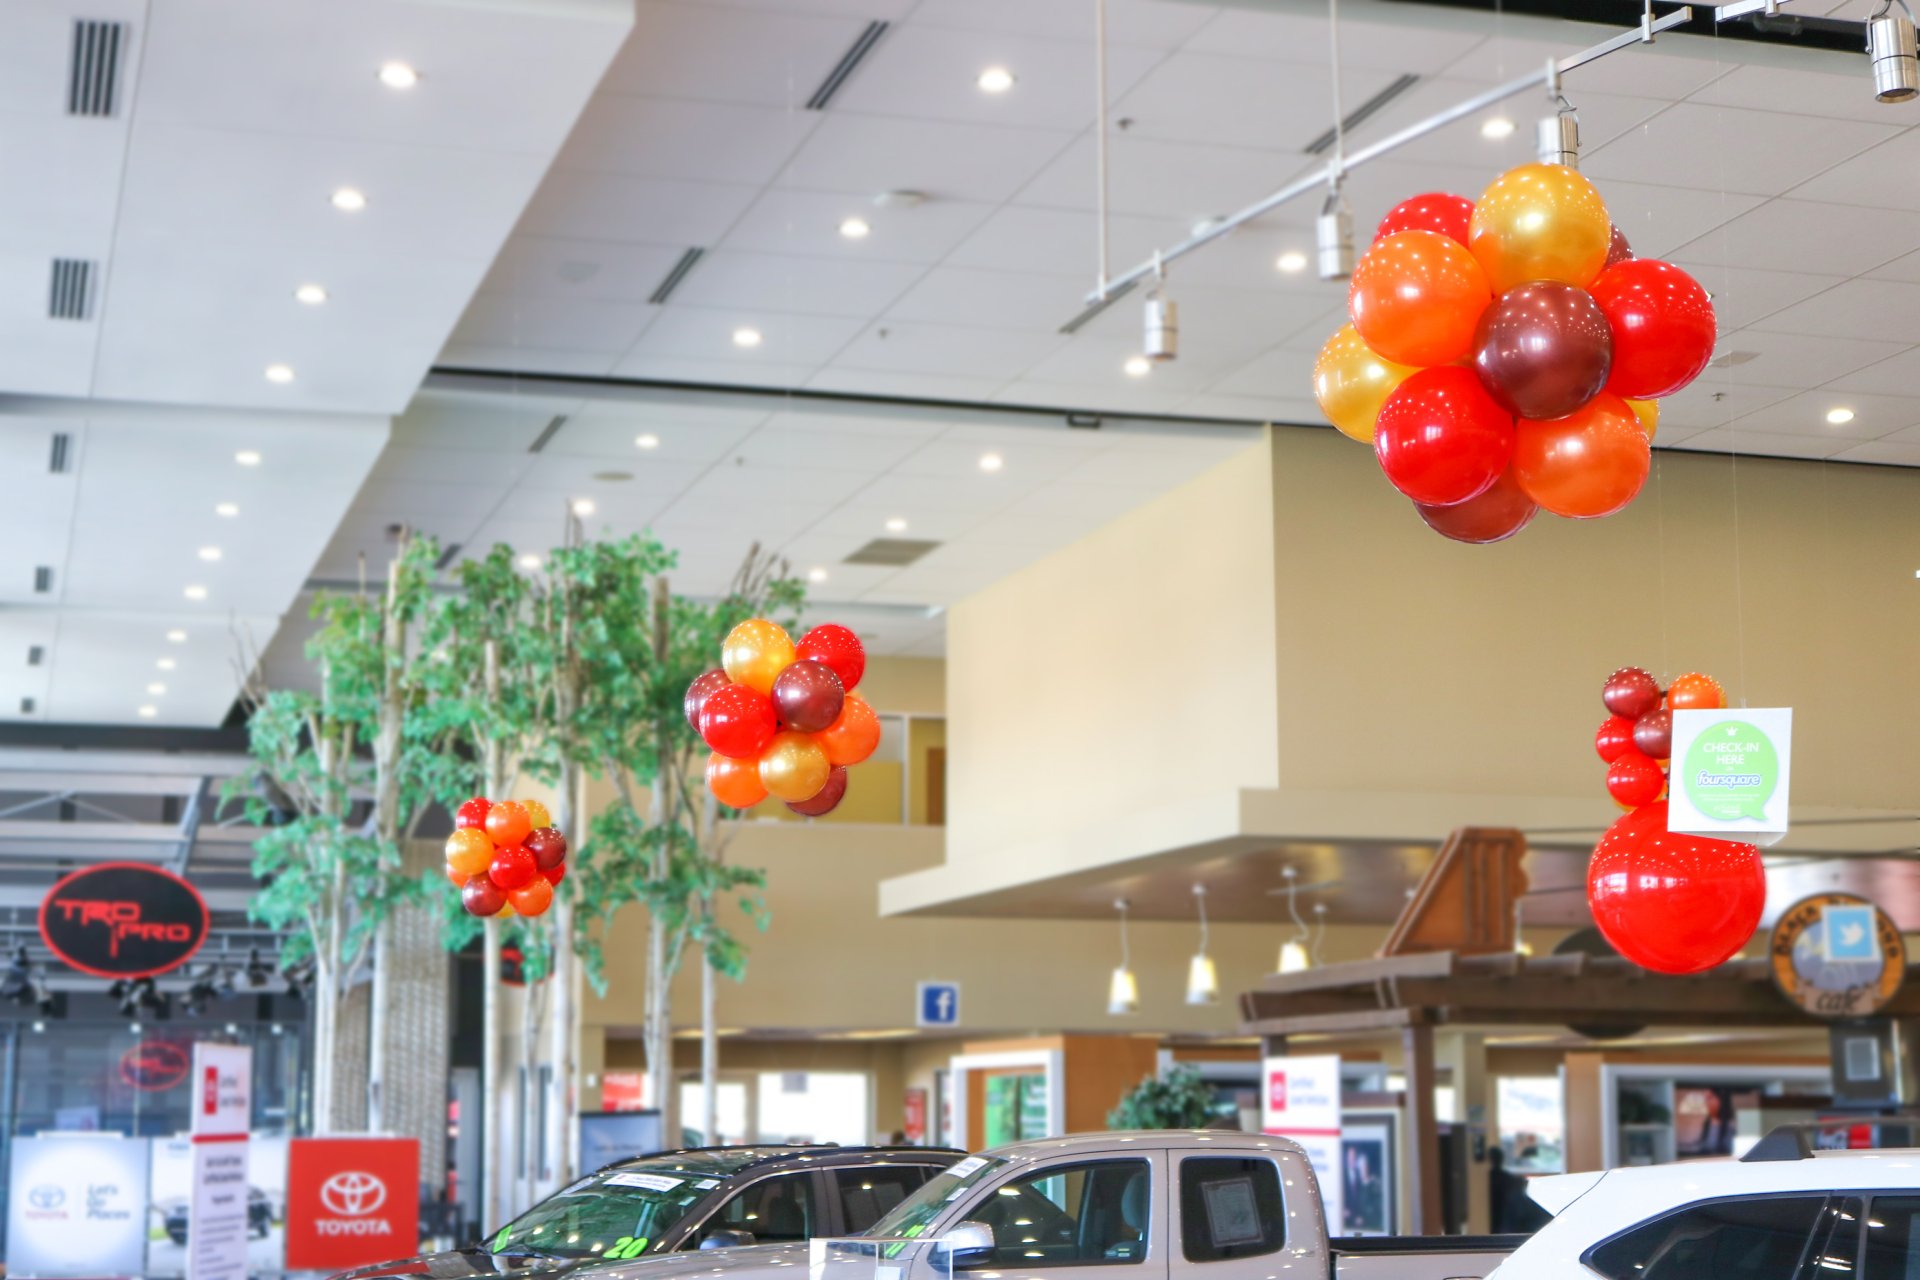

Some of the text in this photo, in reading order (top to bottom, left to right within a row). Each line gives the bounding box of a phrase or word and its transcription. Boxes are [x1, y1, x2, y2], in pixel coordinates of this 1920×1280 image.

[1703, 742, 1760, 752] CHECK-IN
[1715, 754, 1745, 764] HERE
[1698, 771, 1760, 788] foursquare
[118, 923, 192, 942] PRO
[315, 1219, 391, 1236] TOYOTA
[603, 1237, 648, 1259] 20
